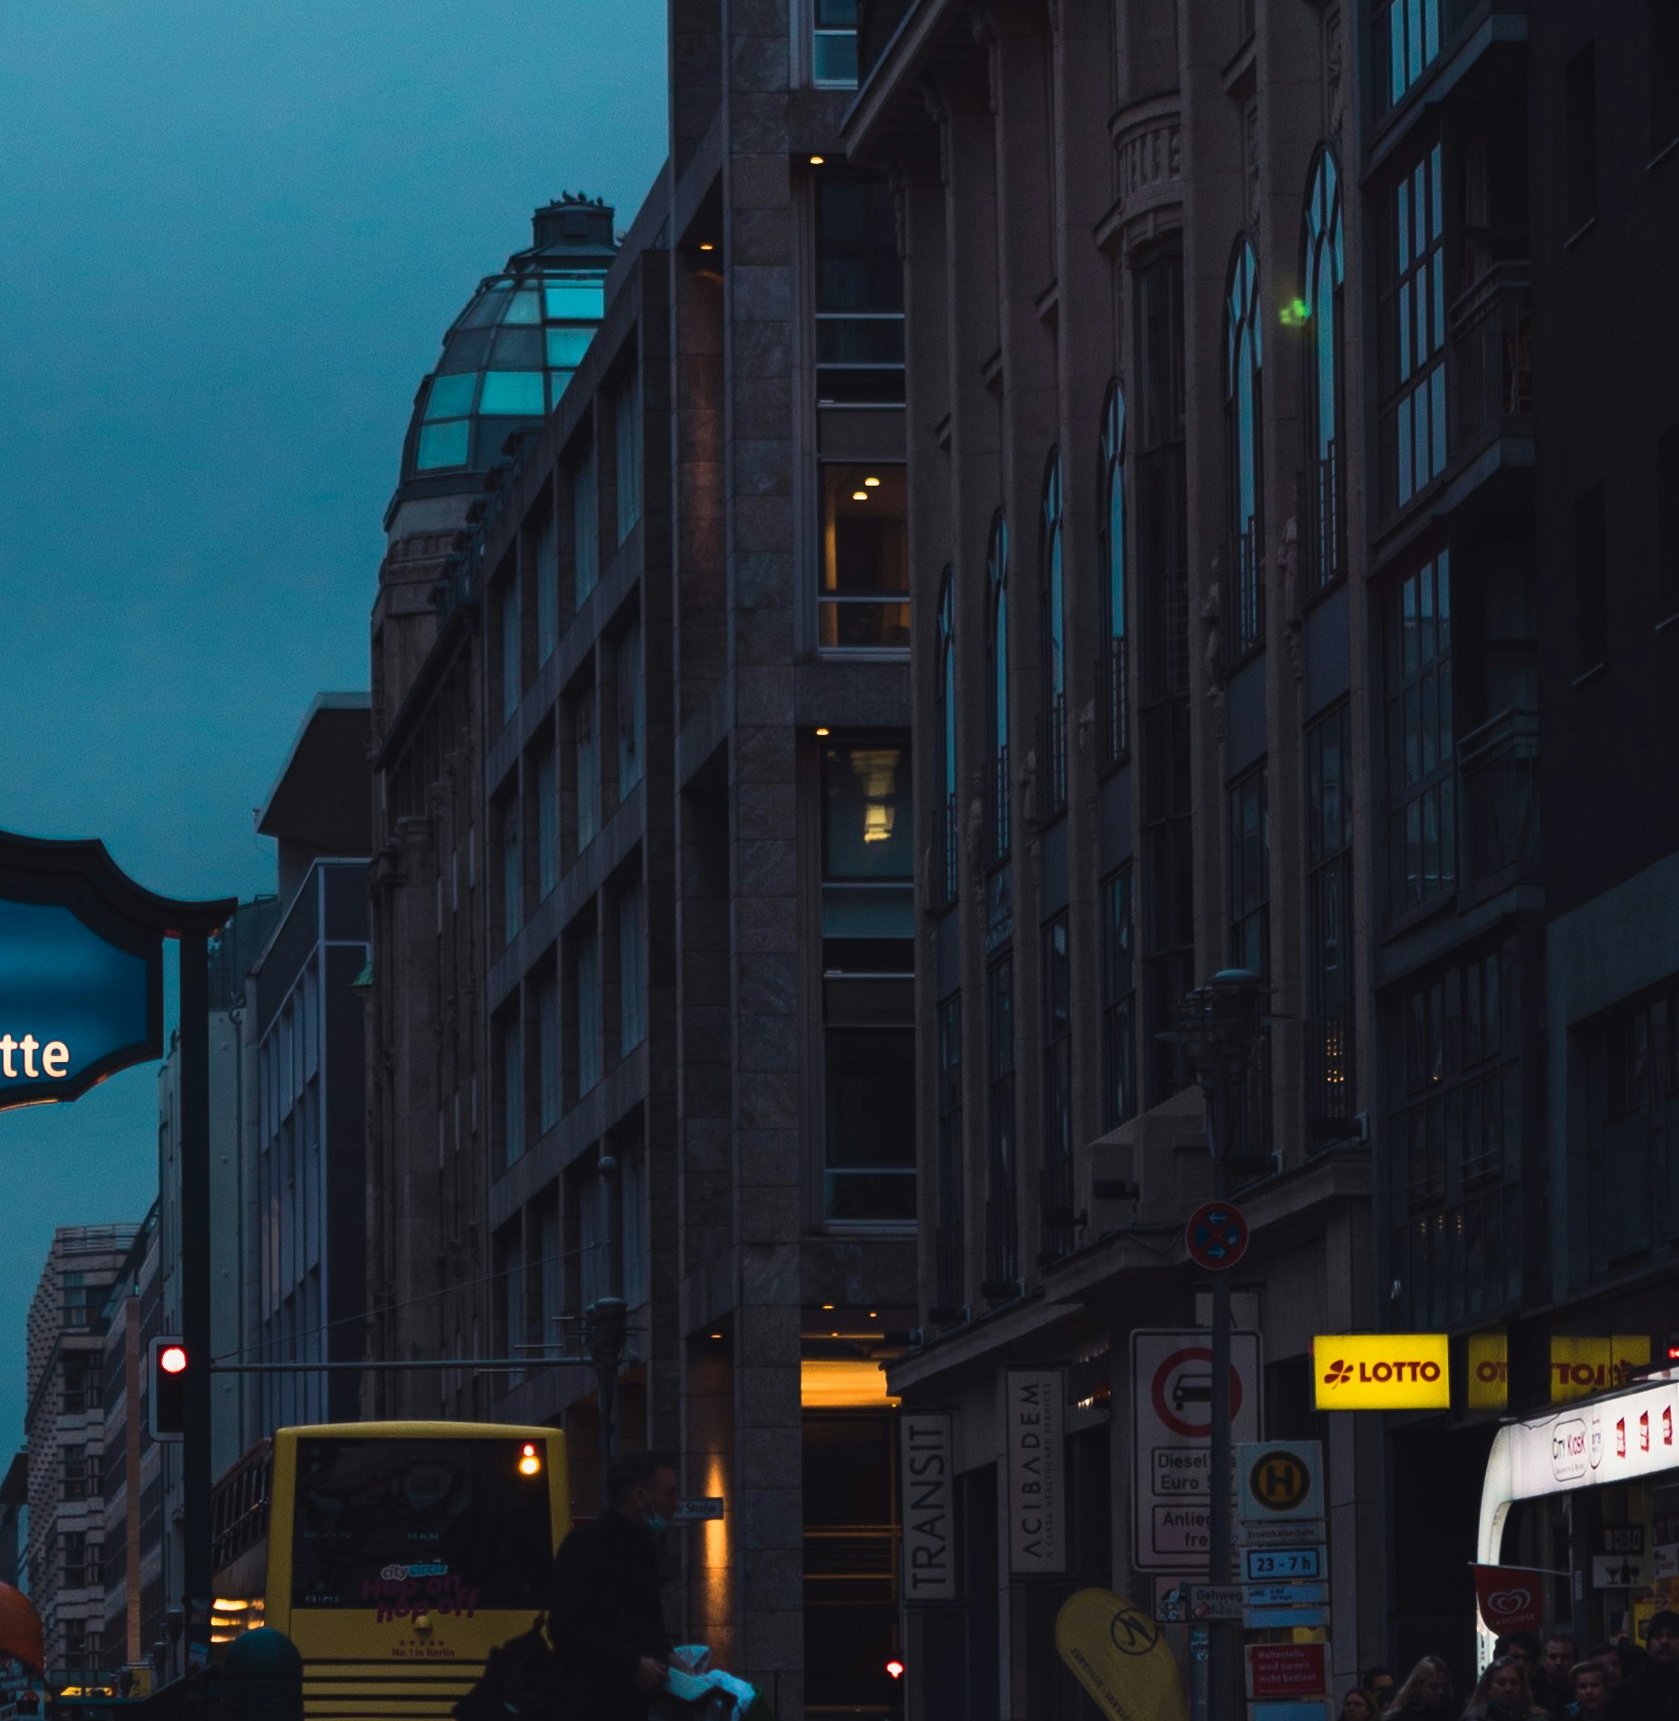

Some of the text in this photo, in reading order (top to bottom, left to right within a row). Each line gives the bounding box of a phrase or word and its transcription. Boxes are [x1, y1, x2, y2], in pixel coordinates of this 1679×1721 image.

[1359, 1361, 1441, 1383] LOTTO
[1158, 1453, 1207, 1468] Diesel
[1021, 1383, 1042, 1559] ACIBADEM
[1160, 1475, 1199, 1490] Euro
[909, 1425, 947, 1591] TRANSIT
[1185, 1532, 1208, 1548] fre
[1257, 1557, 1274, 1572] 23
[1289, 1557, 1298, 1570] 7
[1302, 1556, 1311, 1569] h
[361, 1578, 419, 1606] Hop
[426, 1575, 462, 1596] on
[377, 1588, 481, 1624] hop off
[426, 1647, 455, 1657] Berlin
